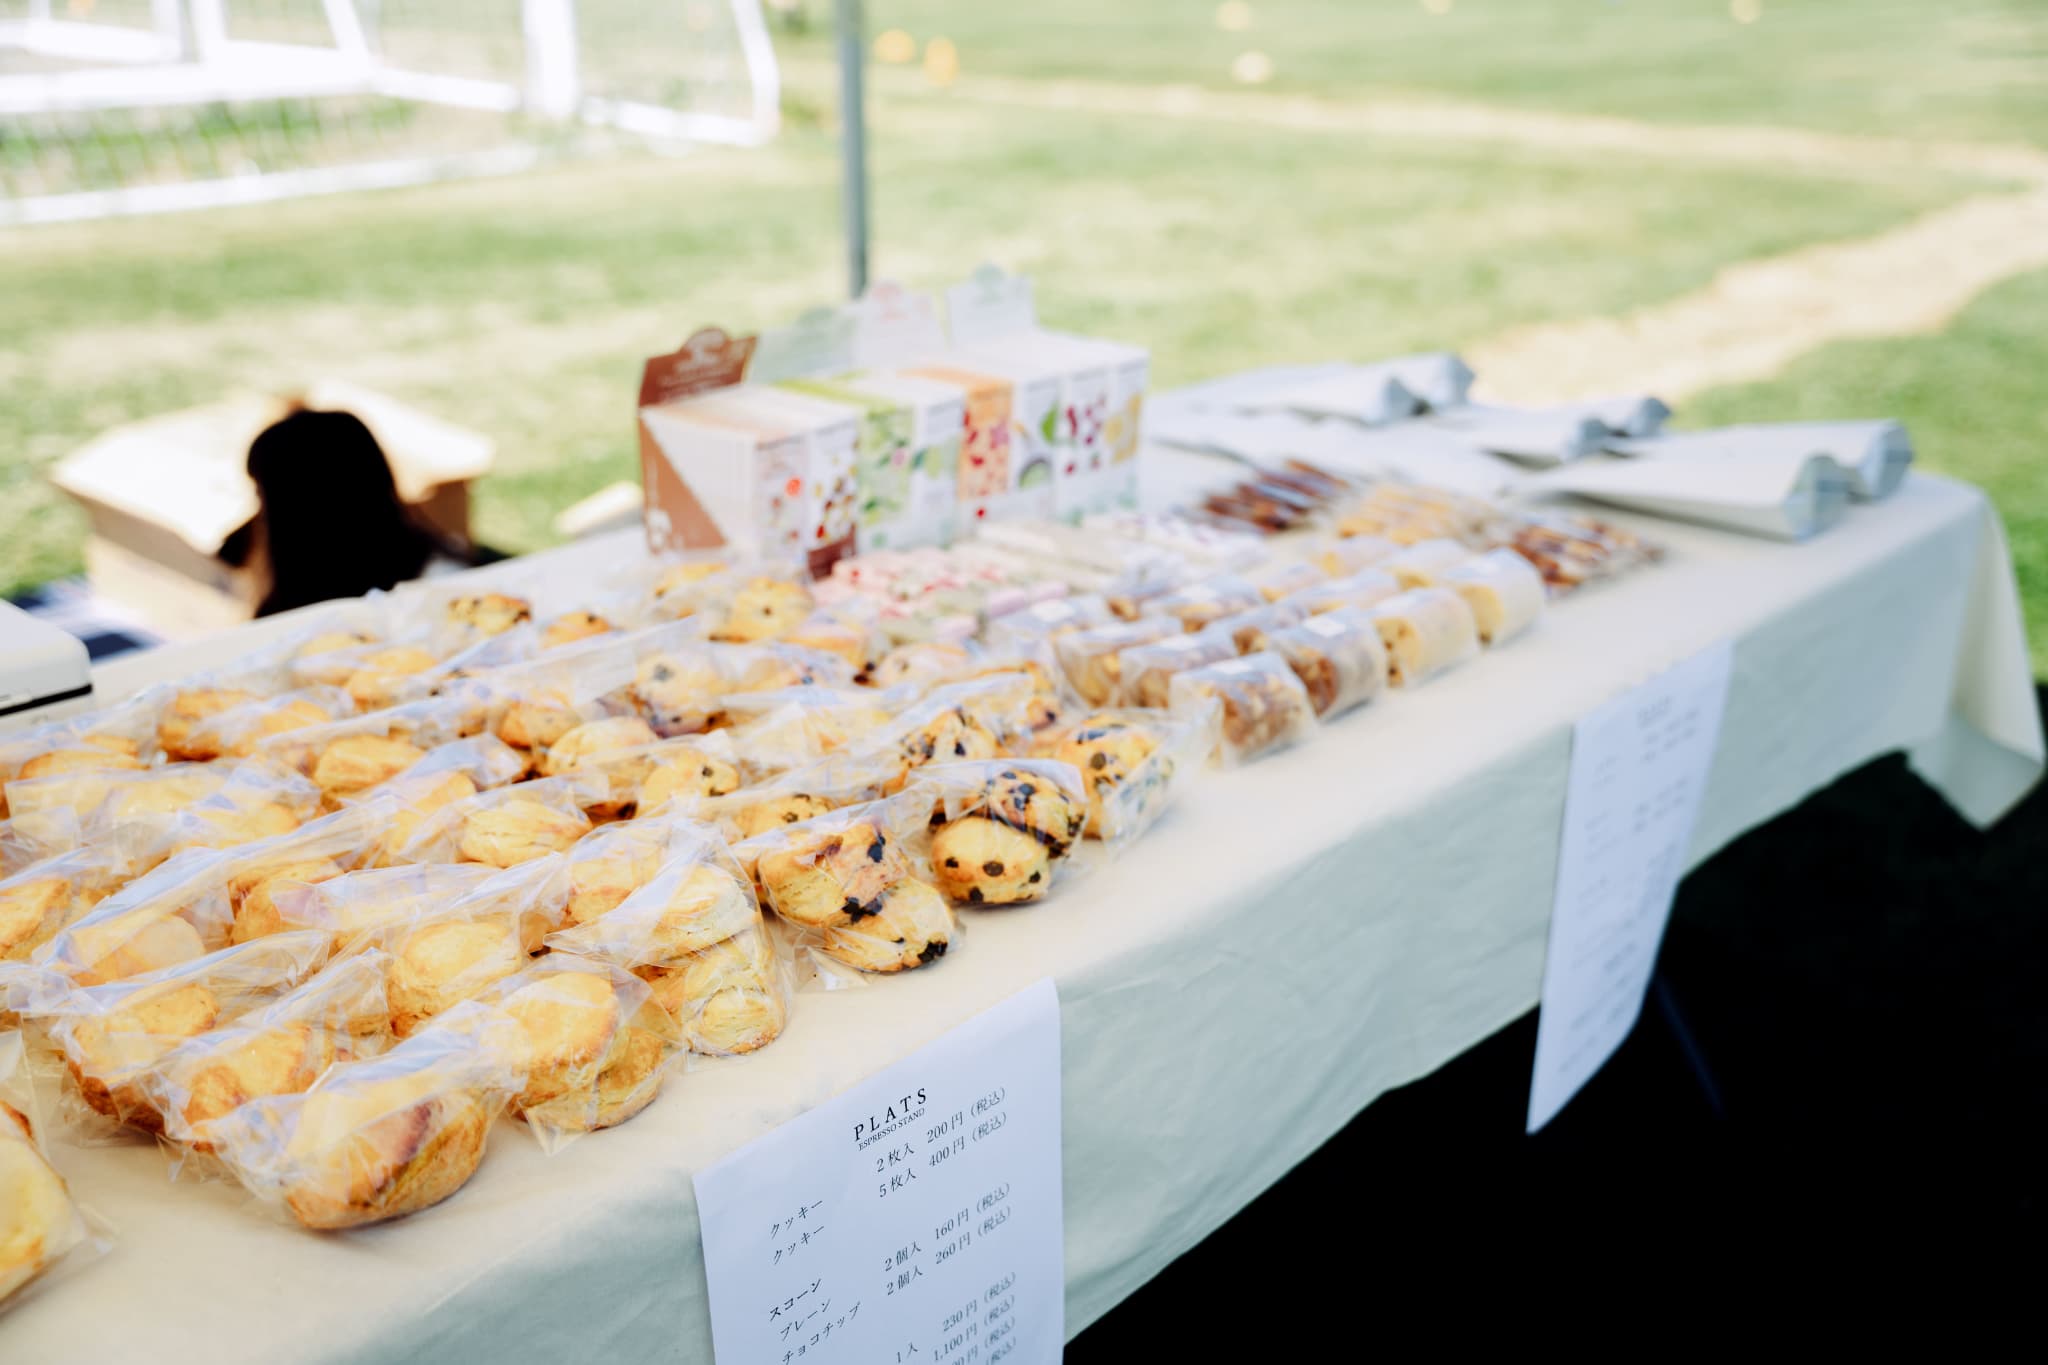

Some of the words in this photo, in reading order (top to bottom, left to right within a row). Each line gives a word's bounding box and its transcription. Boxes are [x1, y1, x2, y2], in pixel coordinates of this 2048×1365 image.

[853, 1087, 927, 1141] PLATS
[858, 1123, 897, 1151] ESPRESSO
[898, 1107, 925, 1128] STAND
[771, 1200, 823, 1240] クッキー
[774, 1226, 824, 1265] クッキー
[770, 1278, 822, 1322] スコーン
